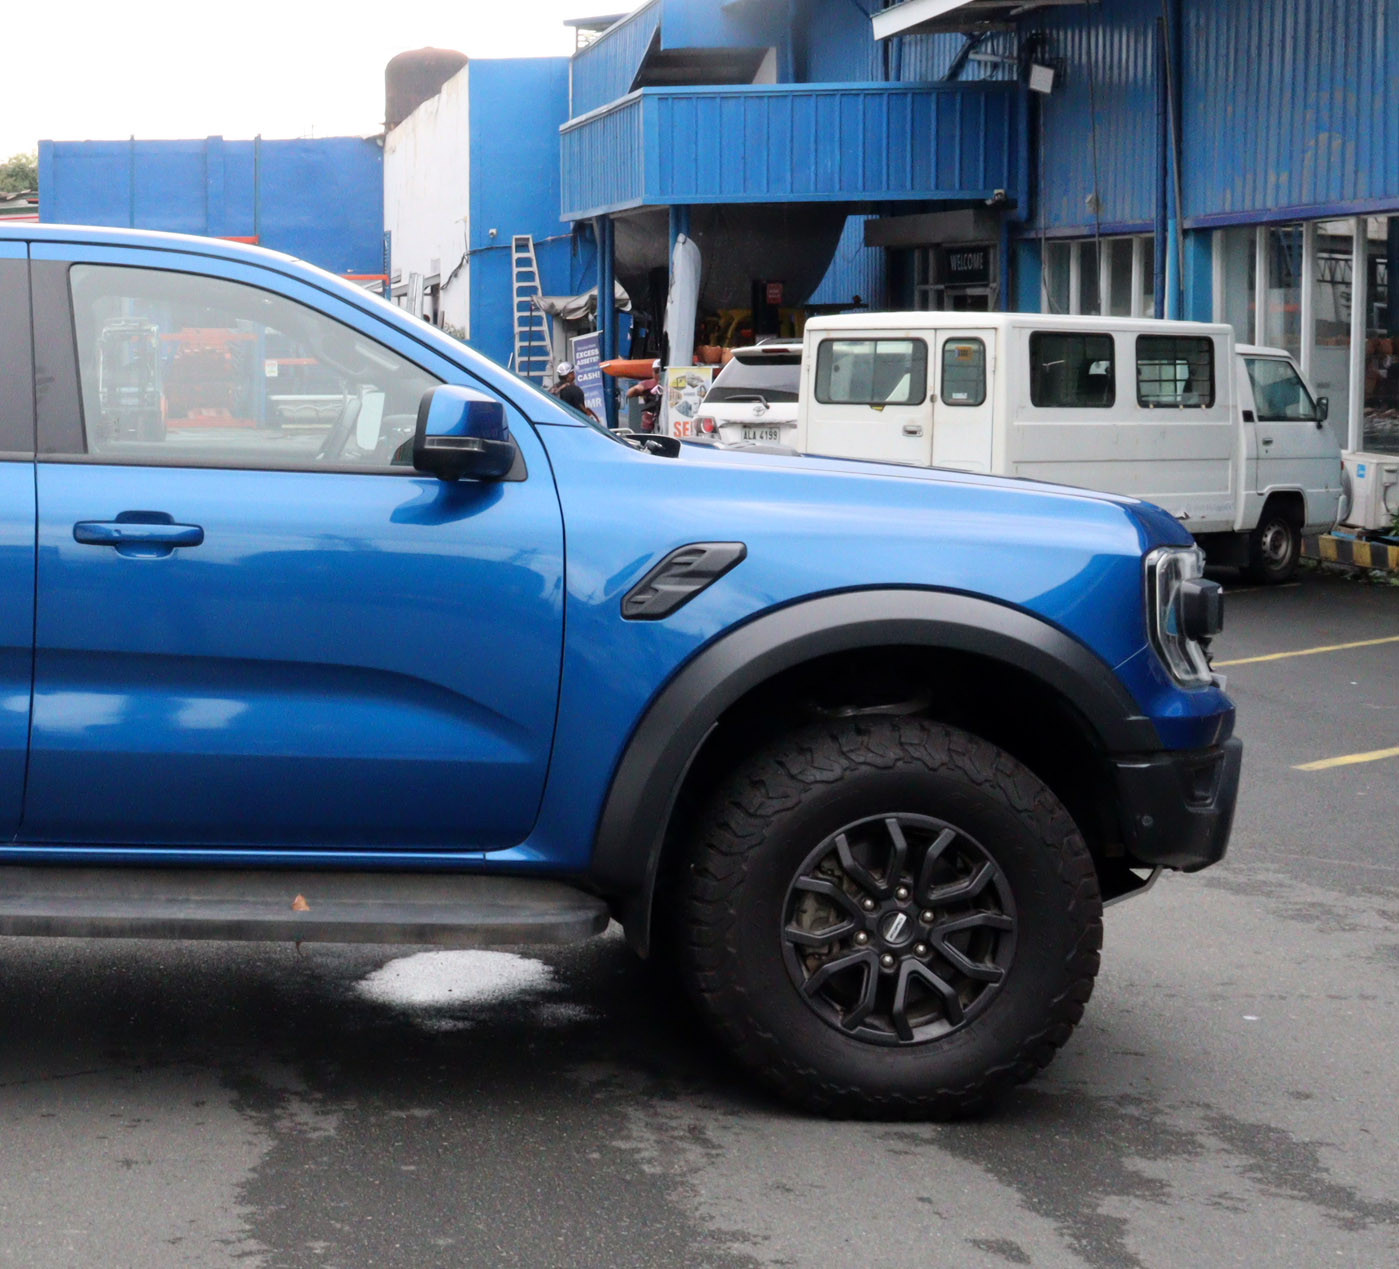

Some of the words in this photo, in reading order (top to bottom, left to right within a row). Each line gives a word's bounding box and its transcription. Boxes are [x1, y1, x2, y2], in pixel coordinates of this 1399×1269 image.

[950, 252, 984, 271] WELCOME
[575, 348, 599, 359] EXCESS
[577, 370, 601, 382] CASH!
[673, 421, 692, 437] SE
[743, 430, 756, 440] ALA
[759, 430, 778, 440] 4199
